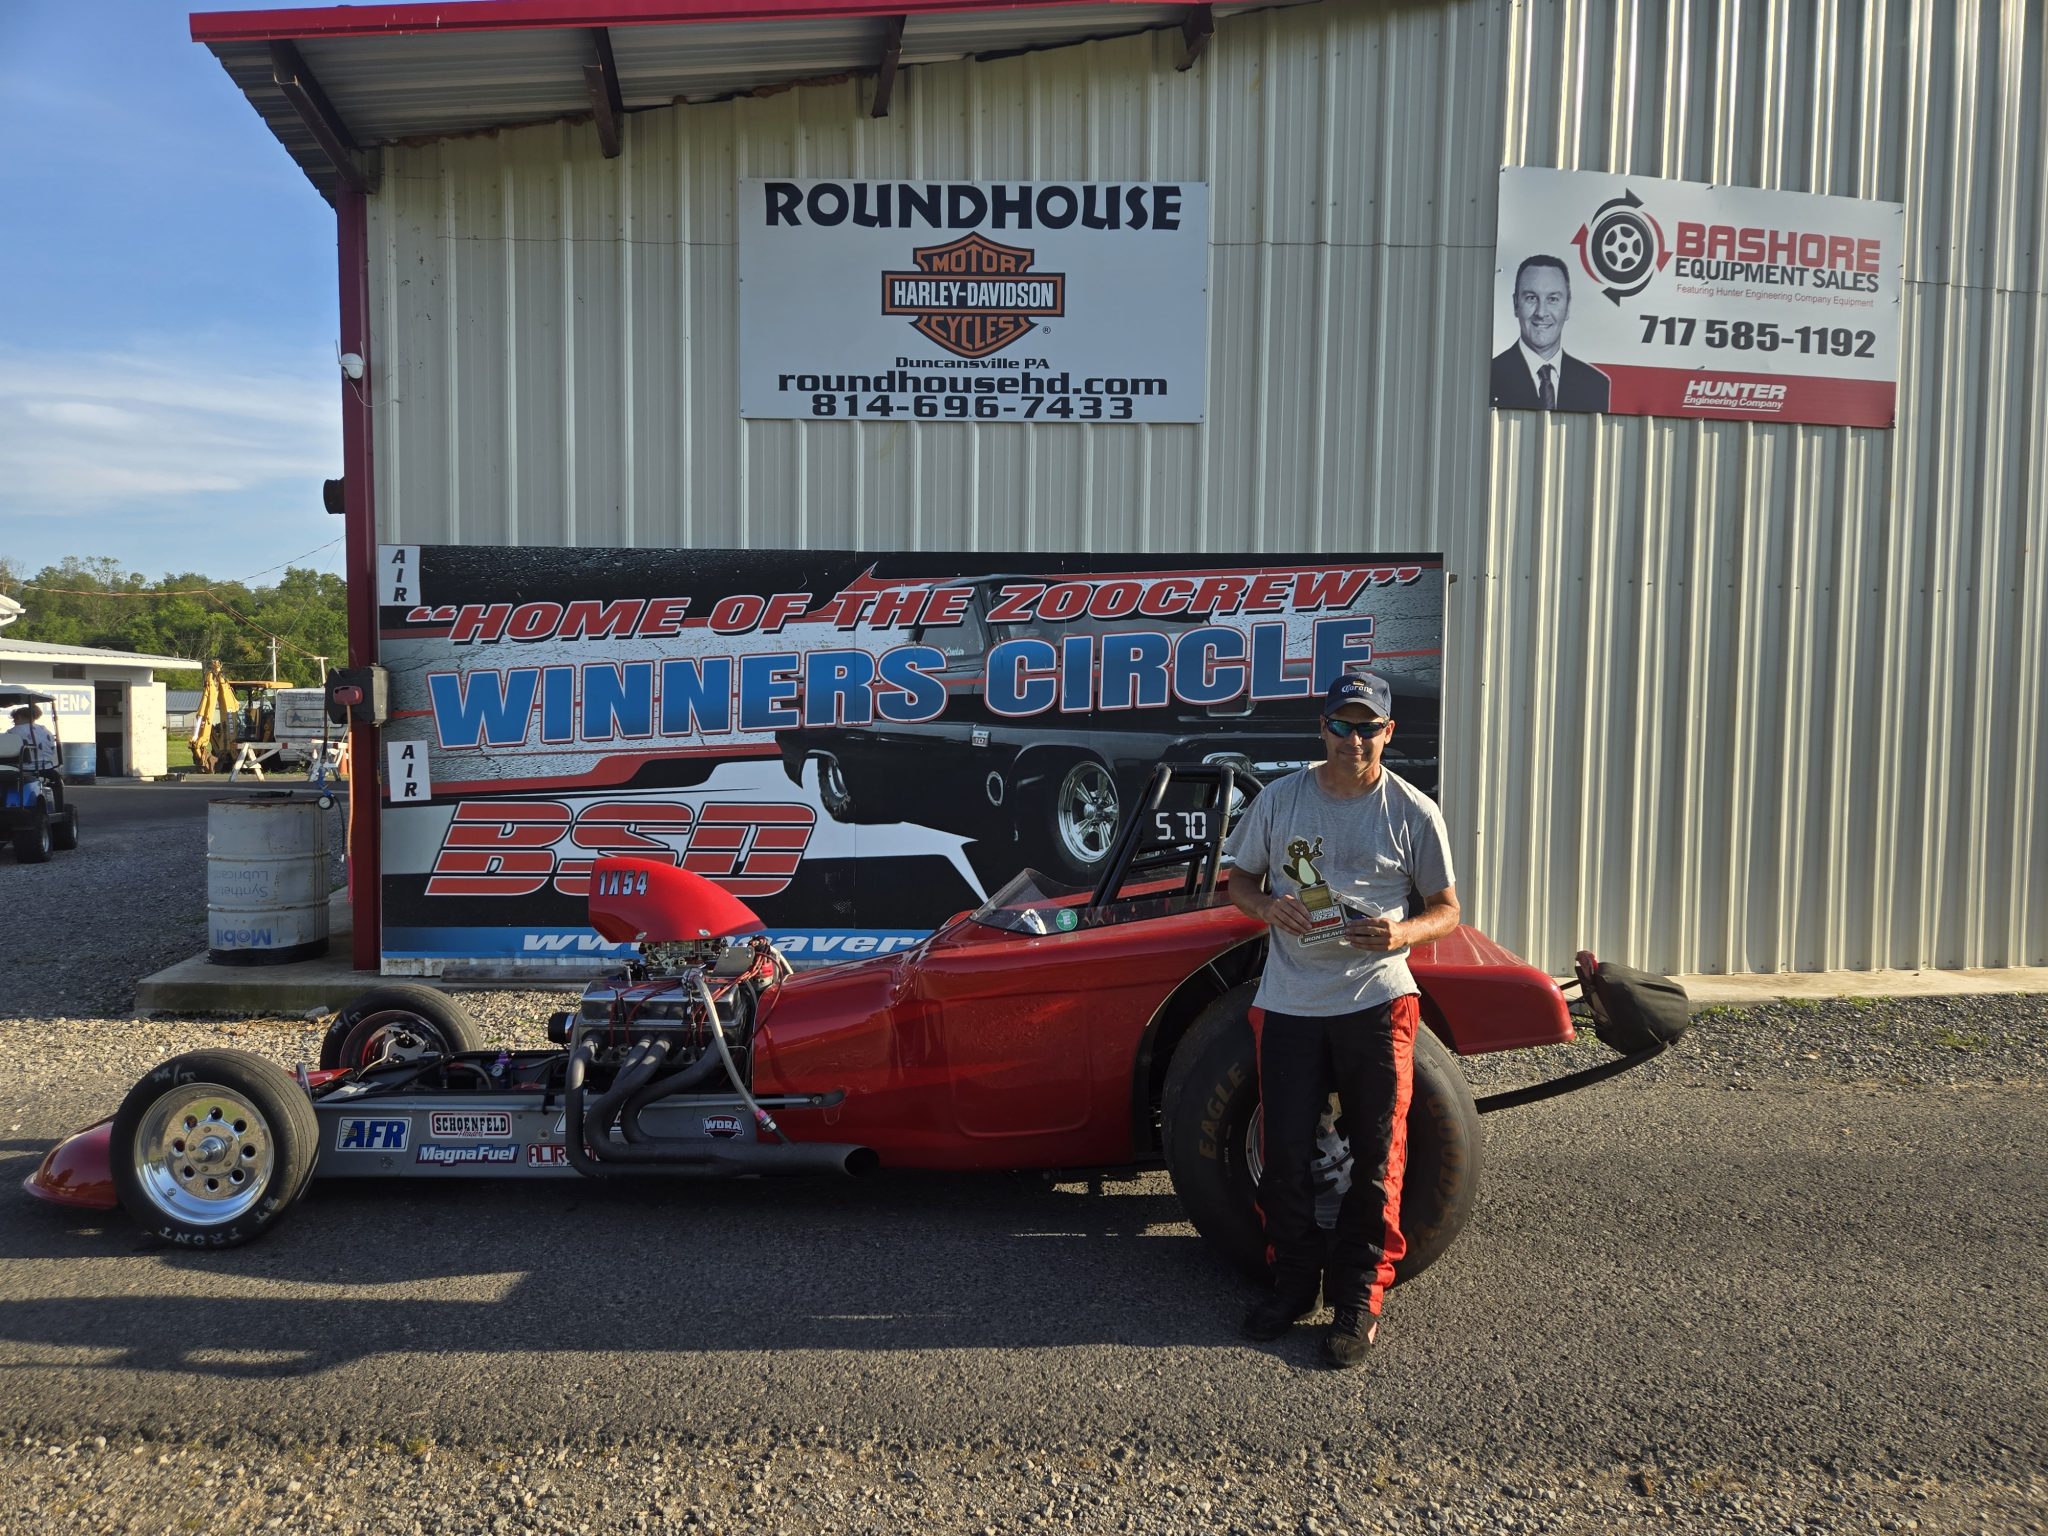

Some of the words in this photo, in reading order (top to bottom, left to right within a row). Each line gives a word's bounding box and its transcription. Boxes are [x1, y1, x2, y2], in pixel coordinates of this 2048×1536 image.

[764, 182, 1182, 231] ROUNDHOUSE
[932, 246, 1016, 273] MOTOR
[1677, 221, 1880, 273] BASHORE
[1675, 257, 1809, 287] EQUIPMENT
[1812, 268, 1879, 293] SALES
[894, 280, 1054, 308] HARLEY-DAVIDSON
[1676, 284, 1714, 297] Featuring
[1716, 286, 1744, 297] Hunter
[1746, 288, 1793, 303] Engineering
[1795, 292, 1831, 306] Company
[1833, 295, 1874, 308] Equipment
[930, 315, 1015, 351] CYCLES
[1639, 314, 1697, 347] 717
[1705, 319, 1876, 358] 585-1192
[895, 356, 1020, 369] Duncansville
[1024, 358, 1050, 370] PA
[778, 370, 1168, 396] roundhousehd.com
[1686, 380, 1787, 400] HUNTER
[812, 394, 1134, 419] 814-696-7433
[1683, 395, 1738, 409] Engineering
[1739, 398, 1783, 410] Company
[391, 548, 408, 603] AIR
[406, 597, 691, 643] “HOME
[708, 593, 812, 633] OF
[834, 586, 973, 629] THE
[987, 567, 1422, 623] ZOOCREW”
[426, 641, 948, 750] WINNERS
[984, 616, 1375, 717] CIRCLE
[401, 743, 418, 798] AIR
[1155, 811, 1207, 841] 5.70
[425, 801, 817, 897] BSD
[599, 870, 649, 897] 1X54
[216, 929, 272, 947] Mobil
[1304, 934, 1321, 943] IRON
[436, 1117, 507, 1132] SCHOENFELD
[1201, 1063, 1247, 1158] EAGLE
[342, 1119, 407, 1148] AFR
[704, 1120, 741, 1131] WDRA
[418, 1145, 517, 1164] MagnaFuel
